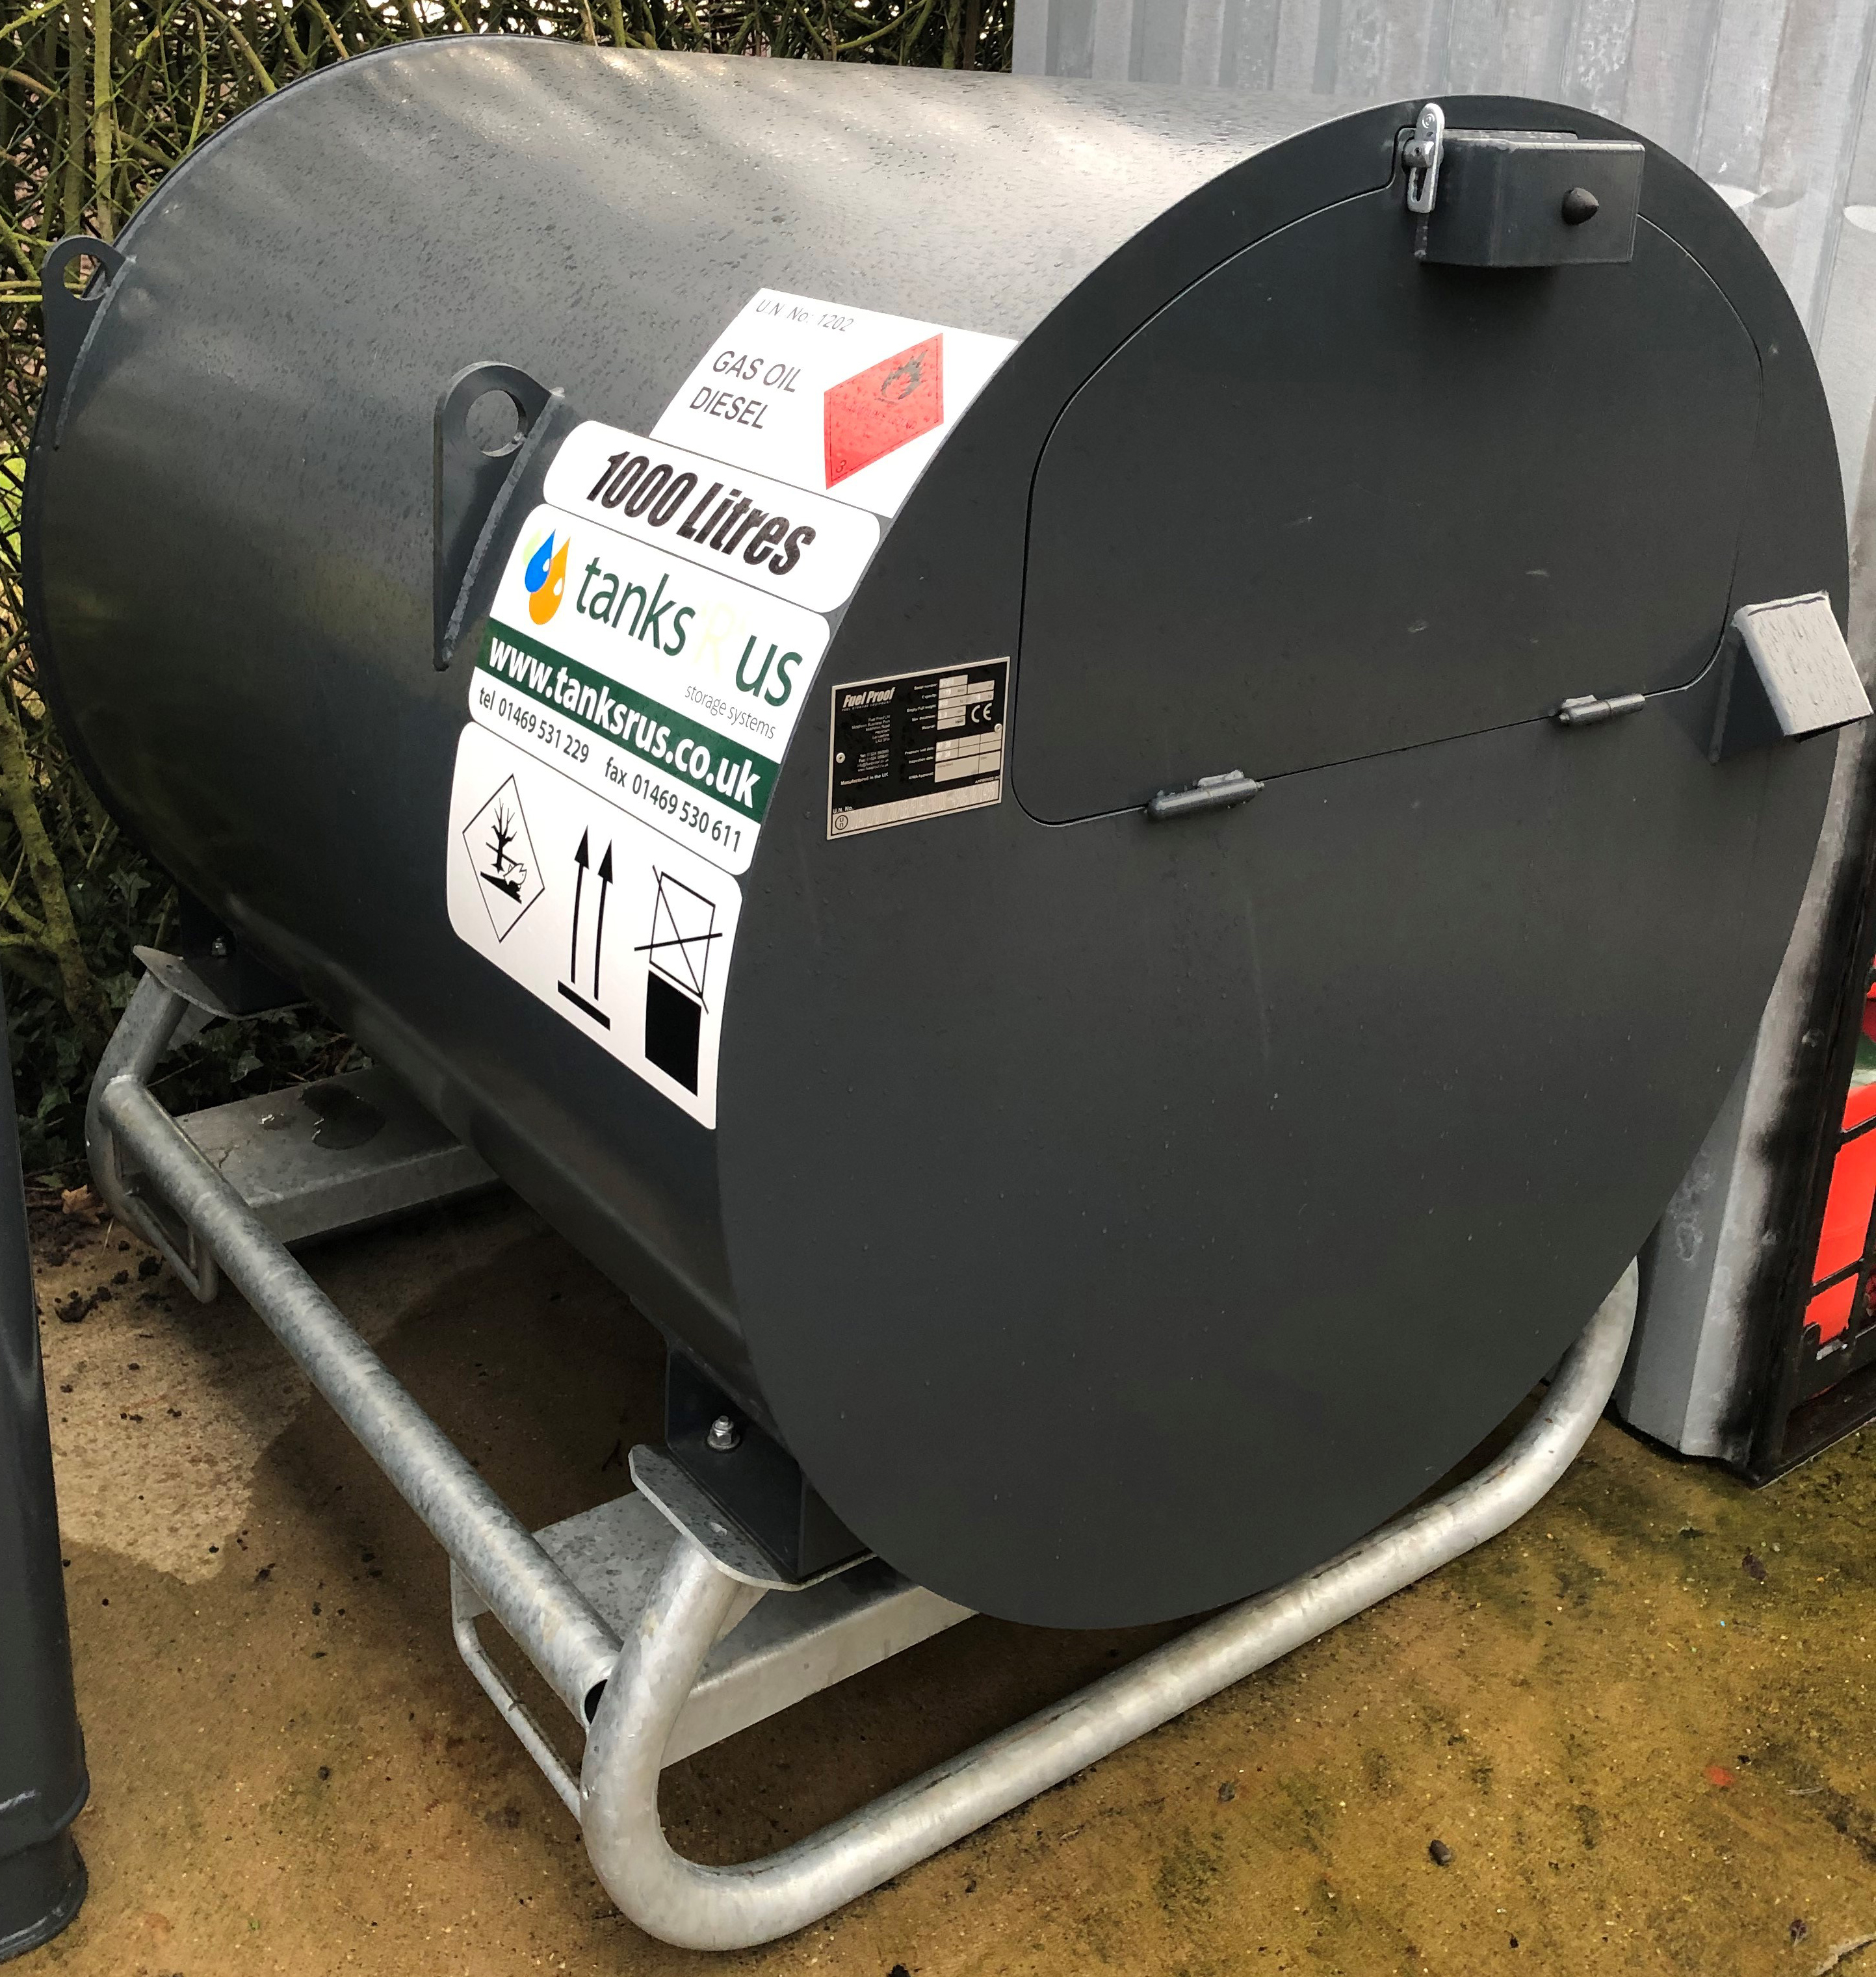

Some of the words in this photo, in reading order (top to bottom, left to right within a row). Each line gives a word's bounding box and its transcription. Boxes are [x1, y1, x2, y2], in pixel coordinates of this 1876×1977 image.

[817, 313, 854, 332] 1202
[712, 350, 764, 380] GAS
[762, 363, 801, 393] OIL
[688, 386, 769, 429] DIESEL
[836, 459, 847, 473] 3
[586, 450, 699, 527] 1000
[675, 482, 816, 575] Litres
[576, 556, 696, 656] tanks
[735, 634, 803, 707] us
[684, 685, 727, 716] storage
[727, 706, 776, 740] systems
[842, 691, 867, 708] Fuel
[865, 686, 896, 704] Proof
[971, 702, 993, 723] CE
[478, 687, 496, 711] tel
[499, 697, 537, 734] 01469
[537, 719, 562, 749] 531
[563, 734, 590, 763] 229
[488, 637, 761, 808] www.tanksrus.co.uk
[605, 756, 627, 788] fax
[632, 774, 678, 815] 01469
[679, 801, 710, 834] 530
[711, 820, 742, 853] 611
